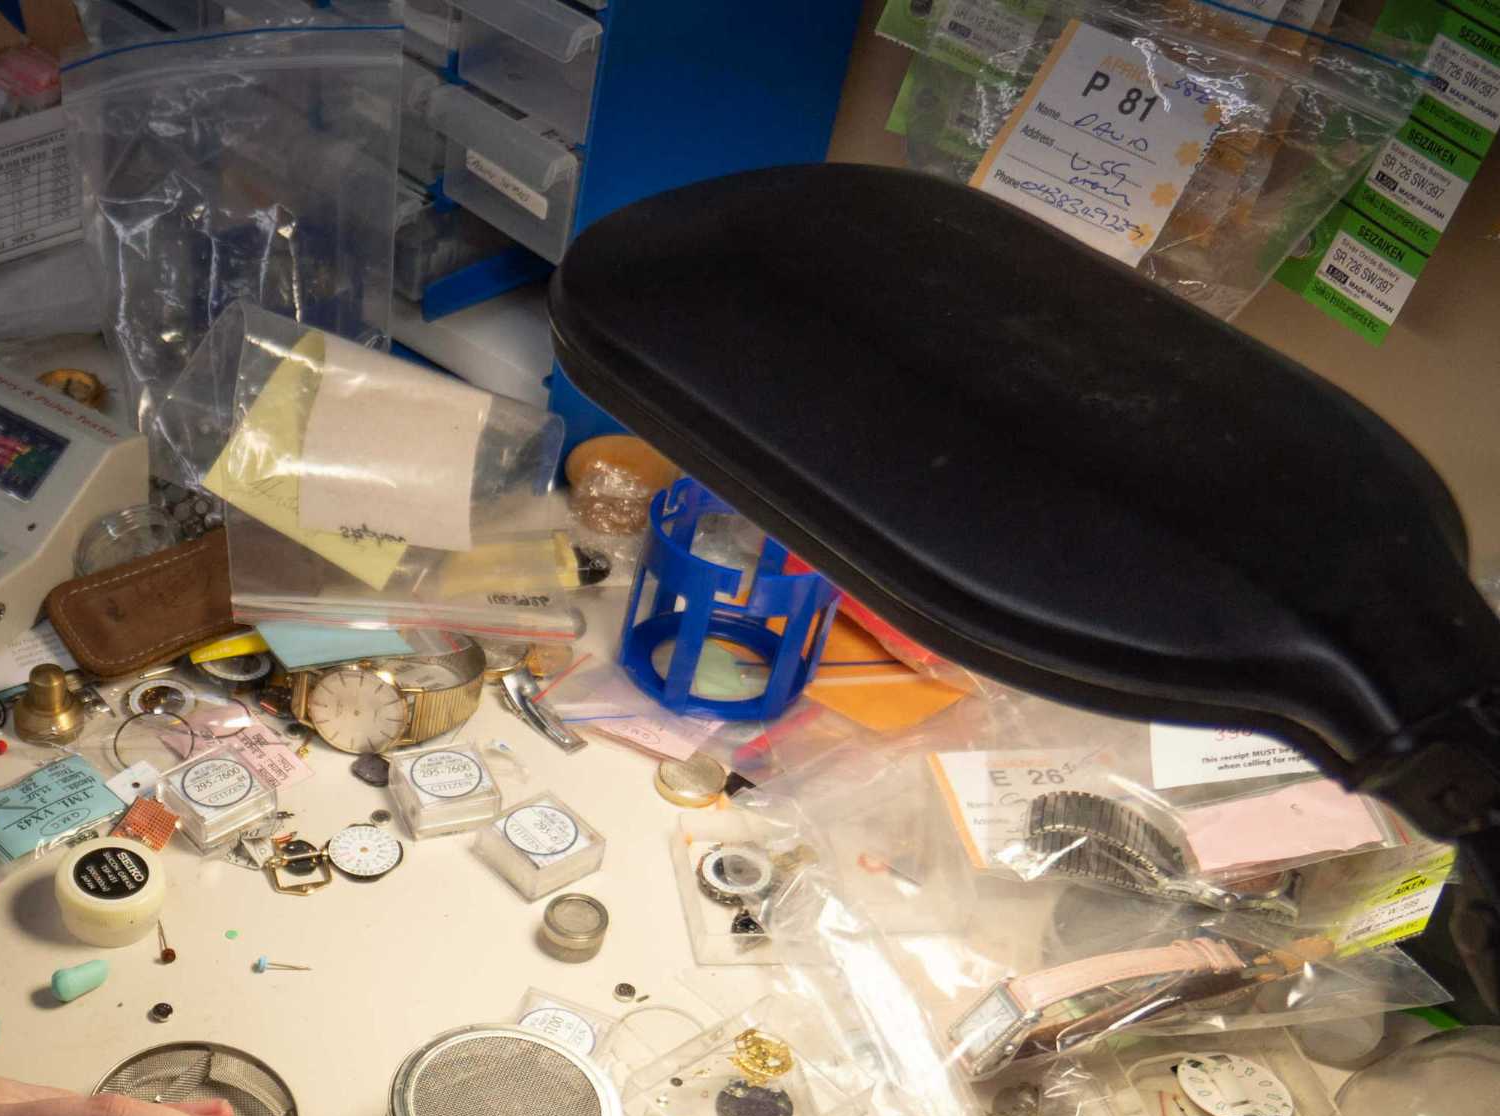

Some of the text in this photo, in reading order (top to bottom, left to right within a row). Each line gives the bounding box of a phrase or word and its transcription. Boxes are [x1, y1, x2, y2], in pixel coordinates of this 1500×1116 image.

[1081, 70, 1110, 97] P
[1117, 86, 1157, 122] 81
[1036, 101, 1061, 120] Name
[1021, 124, 1056, 148] Address
[1405, 127, 1459, 165] SEIZAIKEN
[994, 168, 1021, 188] Phone
[1380, 152, 1398, 170] SR
[1393, 161, 1414, 181] 726
[1354, 223, 1408, 263] SEIZAIKEN
[1331, 247, 1349, 265] SR
[1343, 256, 1364, 276] 726
[1357, 265, 1397, 297] SW/397
[1346, 280, 1367, 295] MADE
[1371, 297, 1394, 314] JAPAN
[1201, 756, 1218, 764] This
[1220, 751, 1249, 763] receipt
[1251, 747, 1276, 757] MUST
[1217, 761, 1241, 771] when
[1243, 758, 1270, 769] calling
[988, 770, 1012, 786] E
[14, 806, 55, 832] VX43
[114, 849, 147, 884] SEIKO
